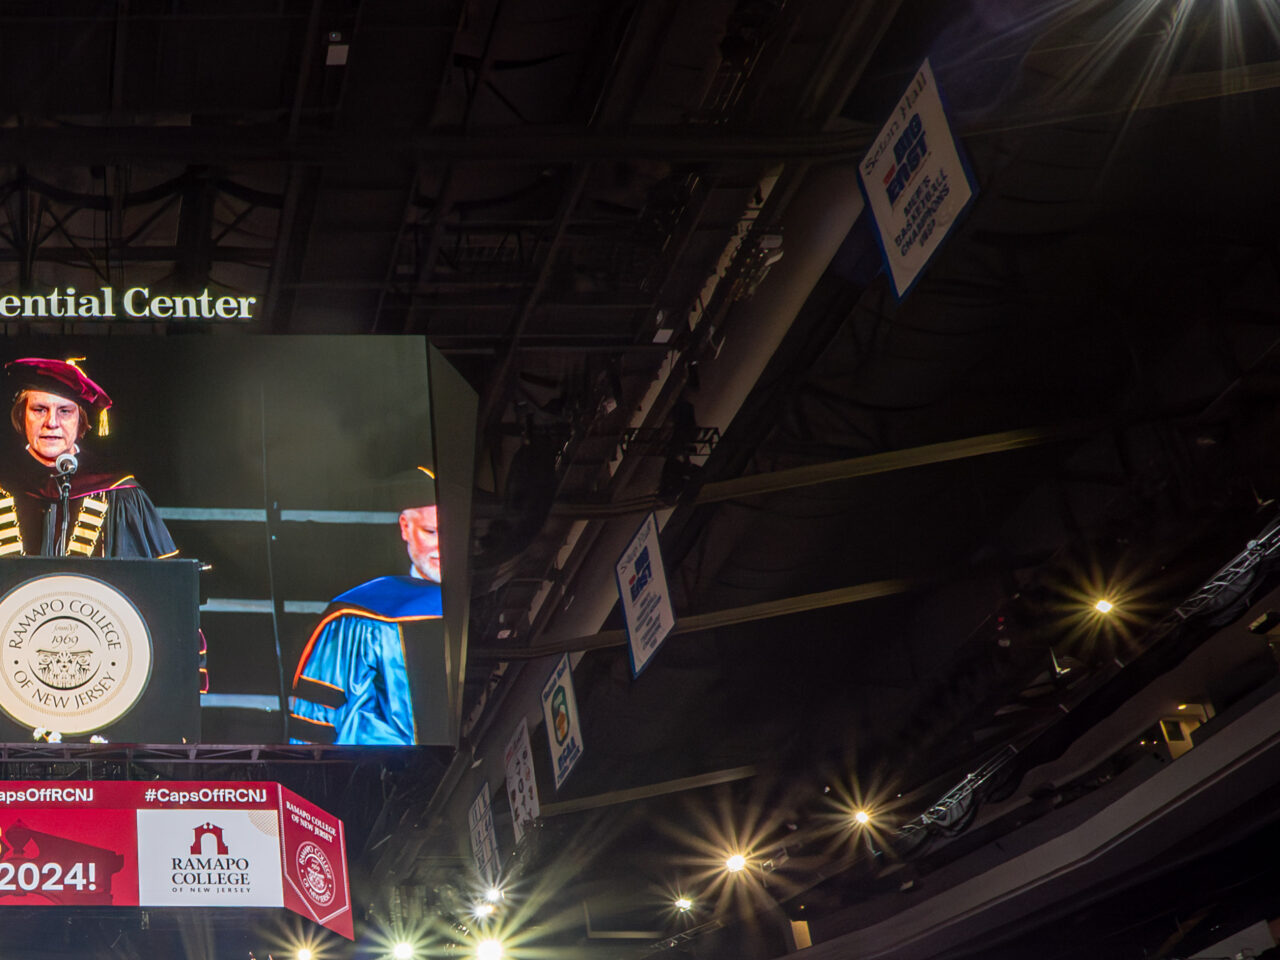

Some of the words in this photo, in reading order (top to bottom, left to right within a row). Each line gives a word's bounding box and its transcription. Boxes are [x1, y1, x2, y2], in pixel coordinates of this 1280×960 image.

[123, 287, 256, 319] Center
[9, 599, 64, 650] RAMAPO
[69, 600, 122, 651] COLLEGE
[51, 635, 80, 649] 1969
[13, 670, 34, 689] OF
[31, 688, 70, 709] NEW
[74, 671, 117, 709] JERSEY
[145, 788, 267, 804] #CapsOffRCNJ
[286, 801, 311, 821] RAMAPO
[311, 815, 336, 836] COLLEGE
[291, 814, 300, 824] OF
[300, 818, 314, 832] NEW
[314, 825, 333, 843] JERSEY
[171, 857, 249, 871] RAMAPO
[171, 872, 250, 886] COLLEGE
